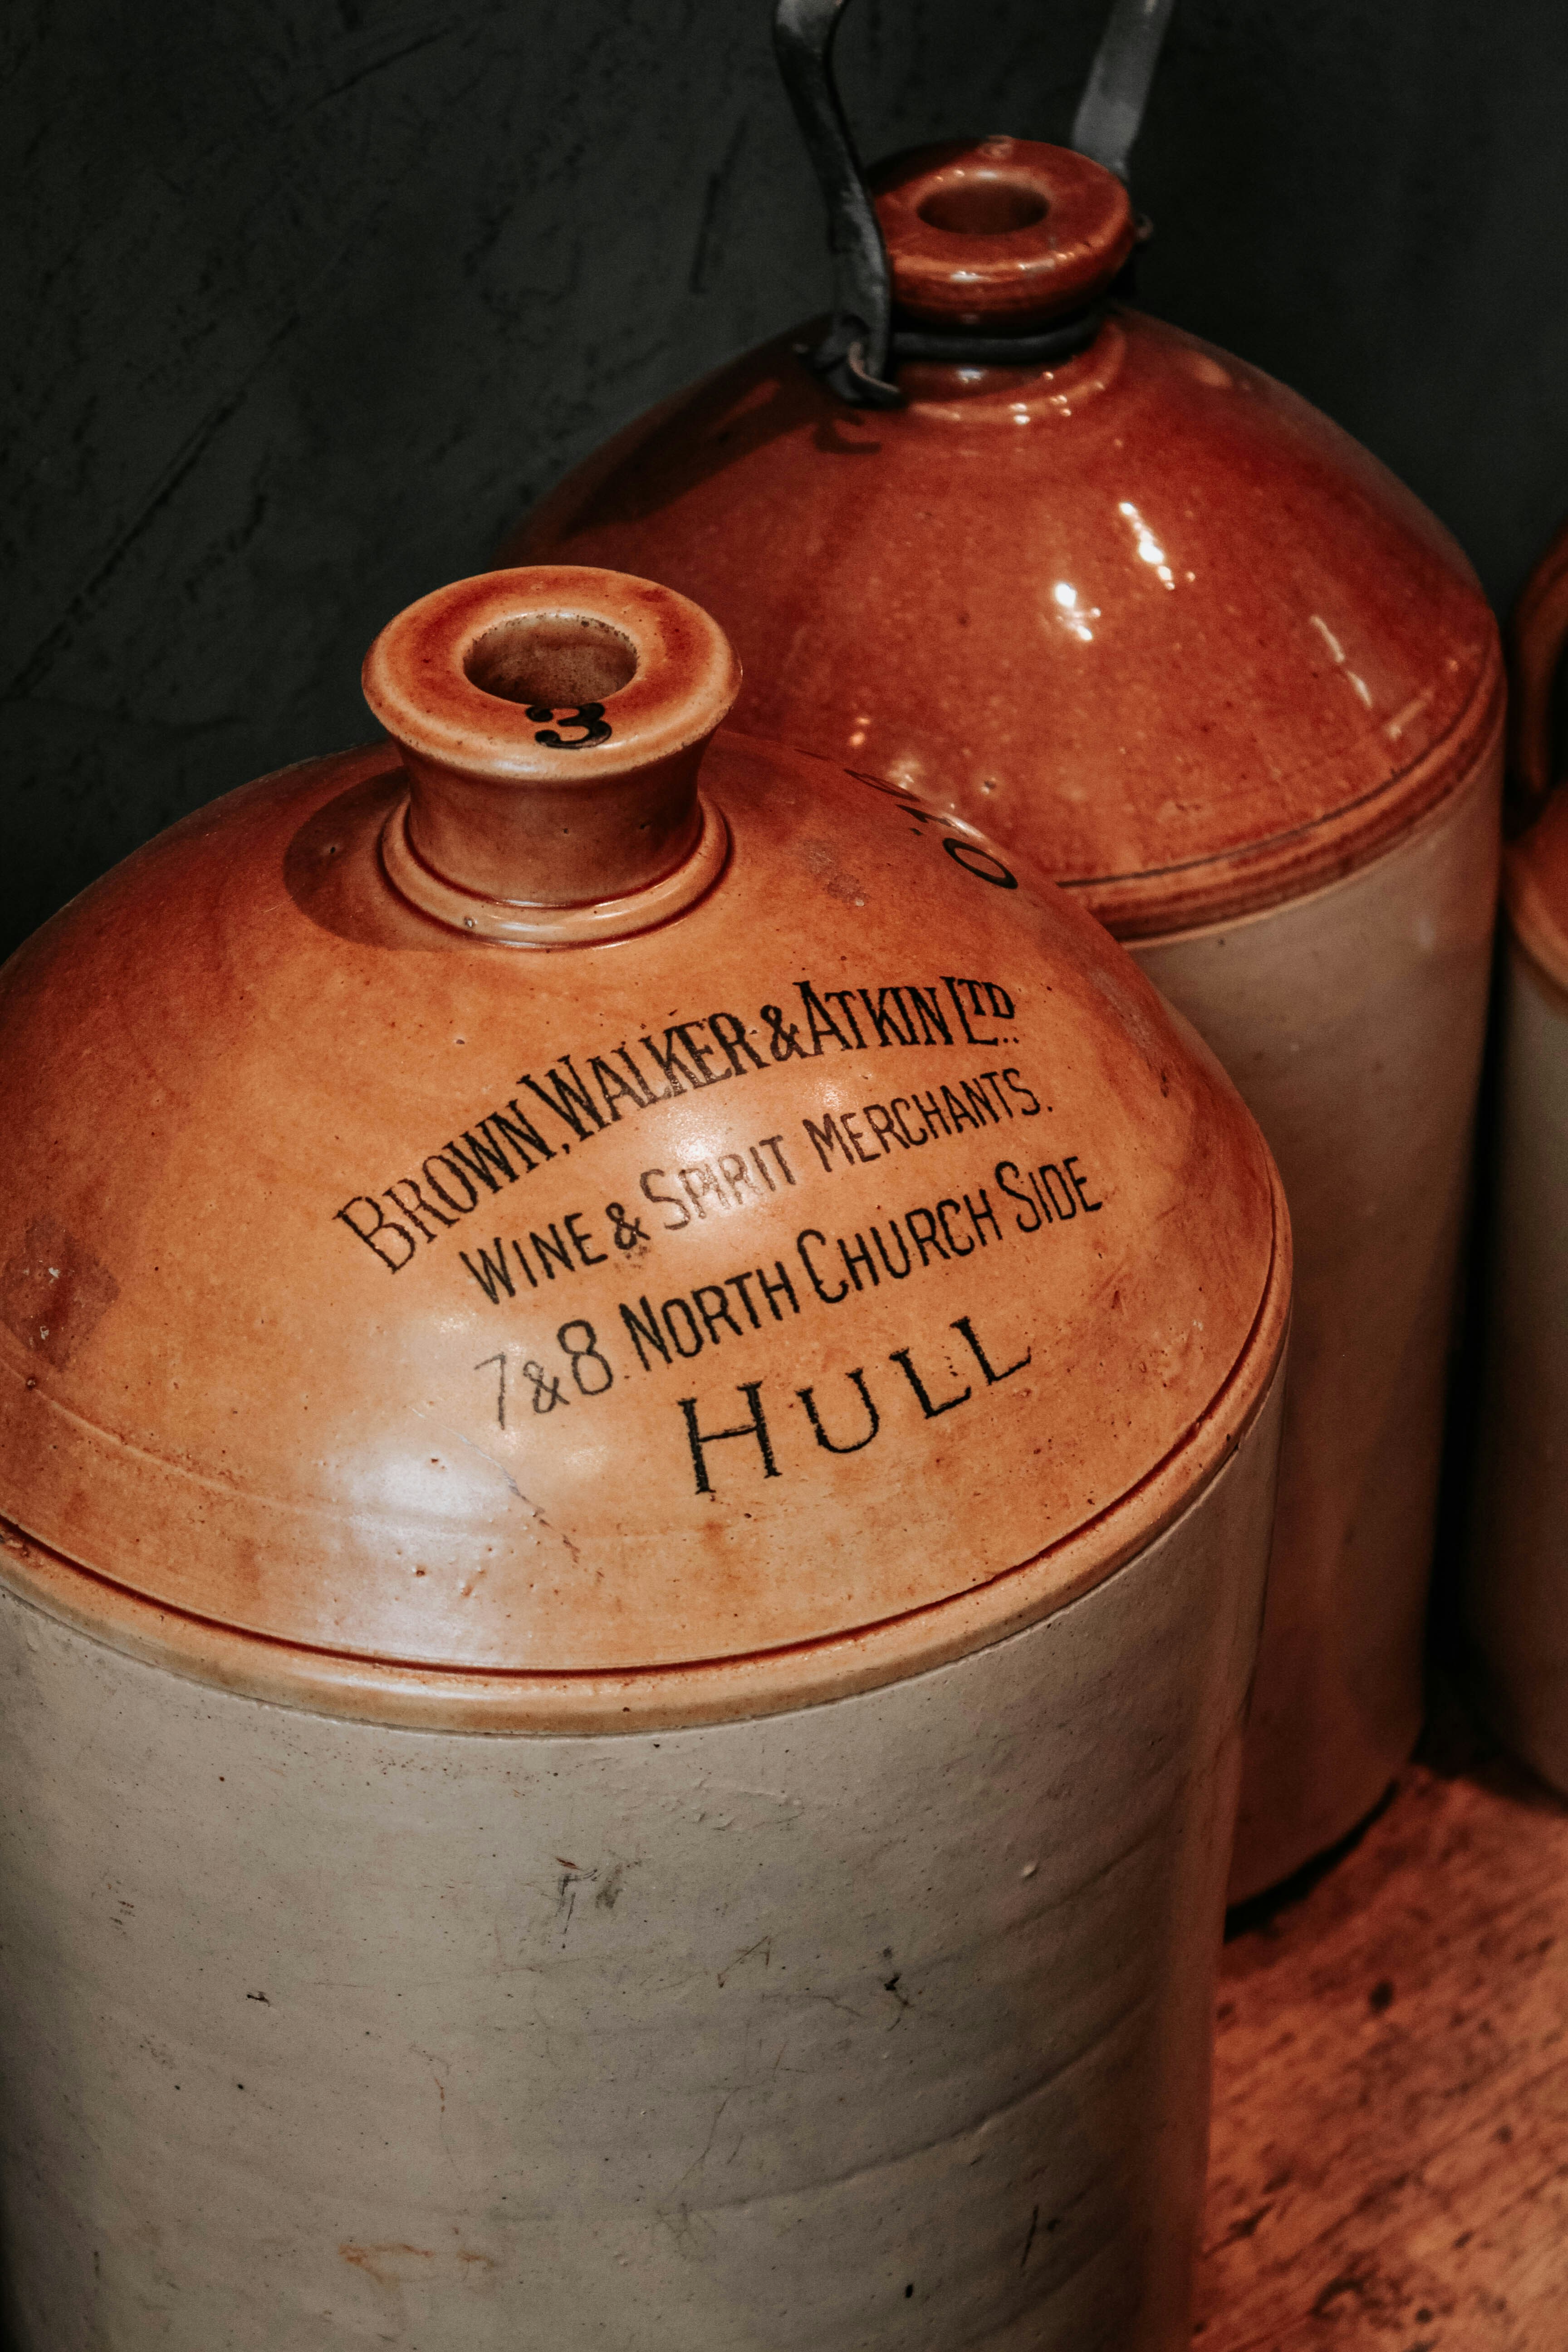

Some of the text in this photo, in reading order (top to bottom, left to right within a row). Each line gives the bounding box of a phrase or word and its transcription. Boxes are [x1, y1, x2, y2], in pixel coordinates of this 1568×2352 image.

[525, 702, 612, 749] 3
[333, 1099, 570, 1274] BROWN,
[517, 1012, 770, 1142] WALKER
[760, 1004, 810, 1061] &
[793, 980, 953, 1058] ATKIN
[459, 1068, 1053, 1305] WINE & SPIRIT MERCHANTS.
[618, 1260, 800, 1371] NORTH
[797, 1189, 1003, 1303] CHURCH
[994, 1156, 1102, 1233] SIDE
[677, 1316, 1032, 1494] HULL
